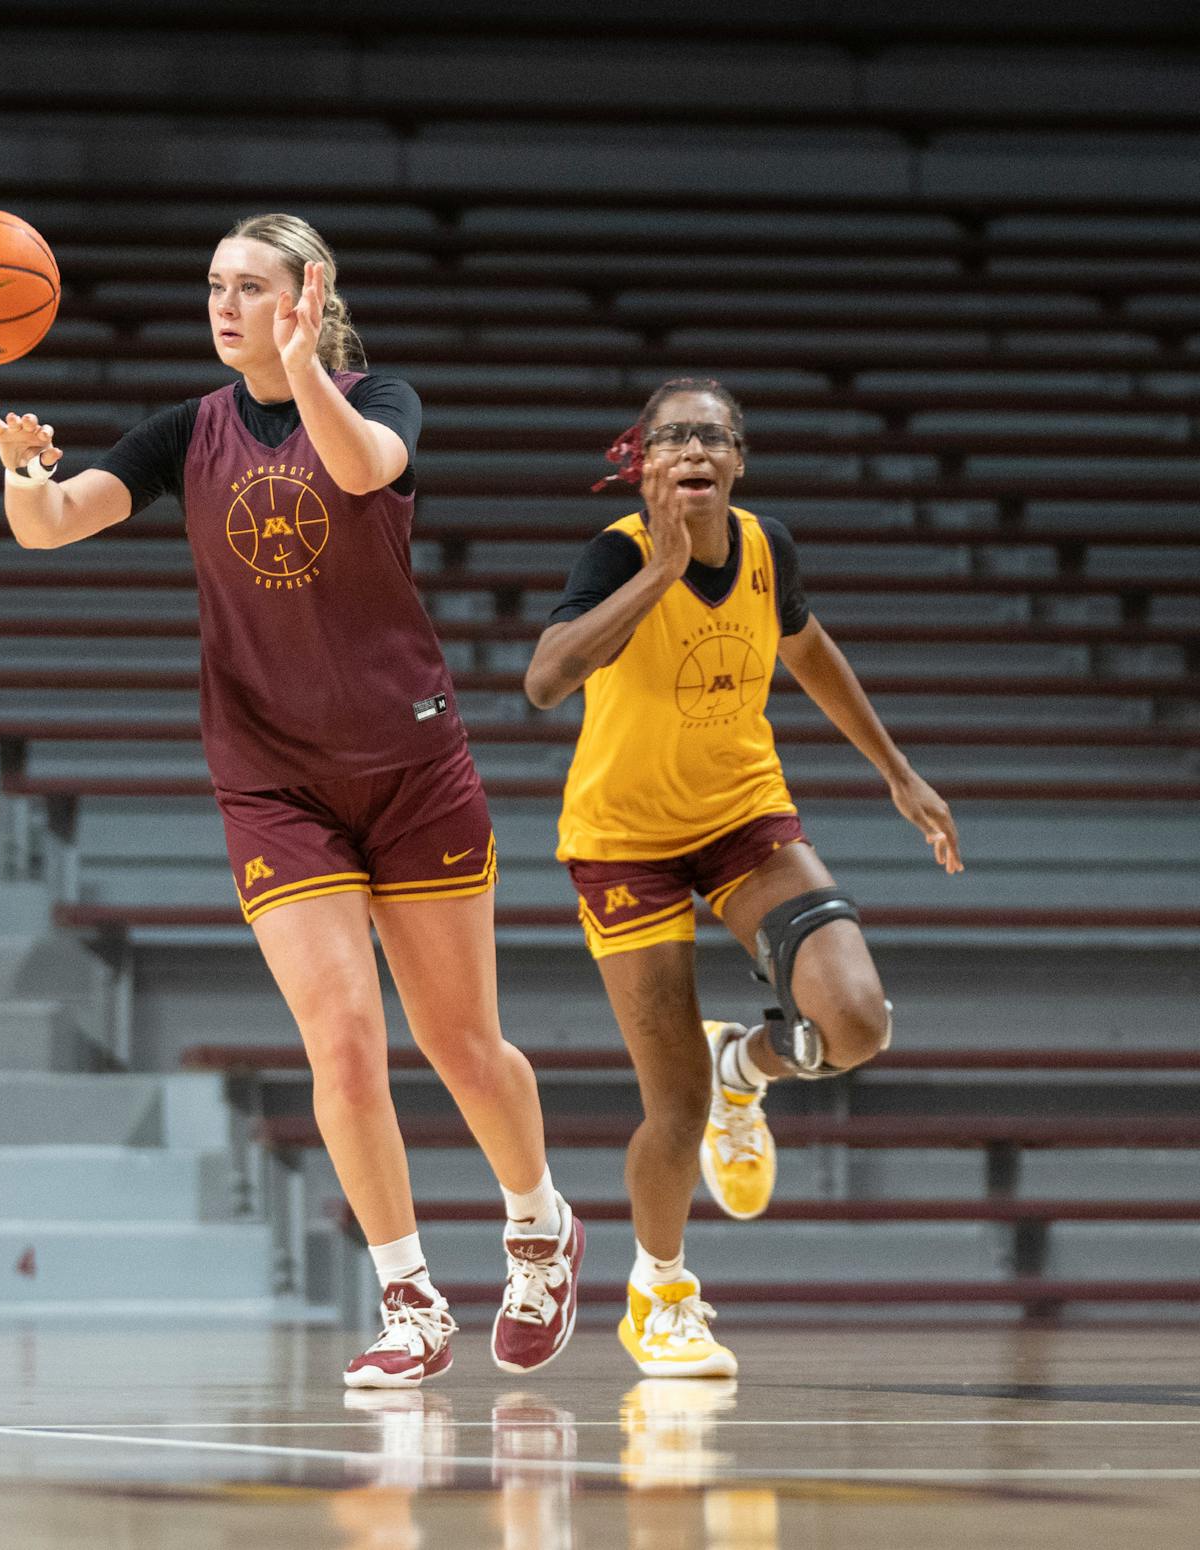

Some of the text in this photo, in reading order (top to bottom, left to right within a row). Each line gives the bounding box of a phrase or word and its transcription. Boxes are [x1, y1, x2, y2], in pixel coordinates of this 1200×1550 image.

[230, 464, 314, 492] MINNESOTA
[262, 516, 294, 539] M
[255, 567, 320, 590] GOPHERS
[707, 674, 736, 693] M
[245, 855, 275, 889] M
[604, 883, 640, 914] M
[16, 1246, 37, 1280] 4
